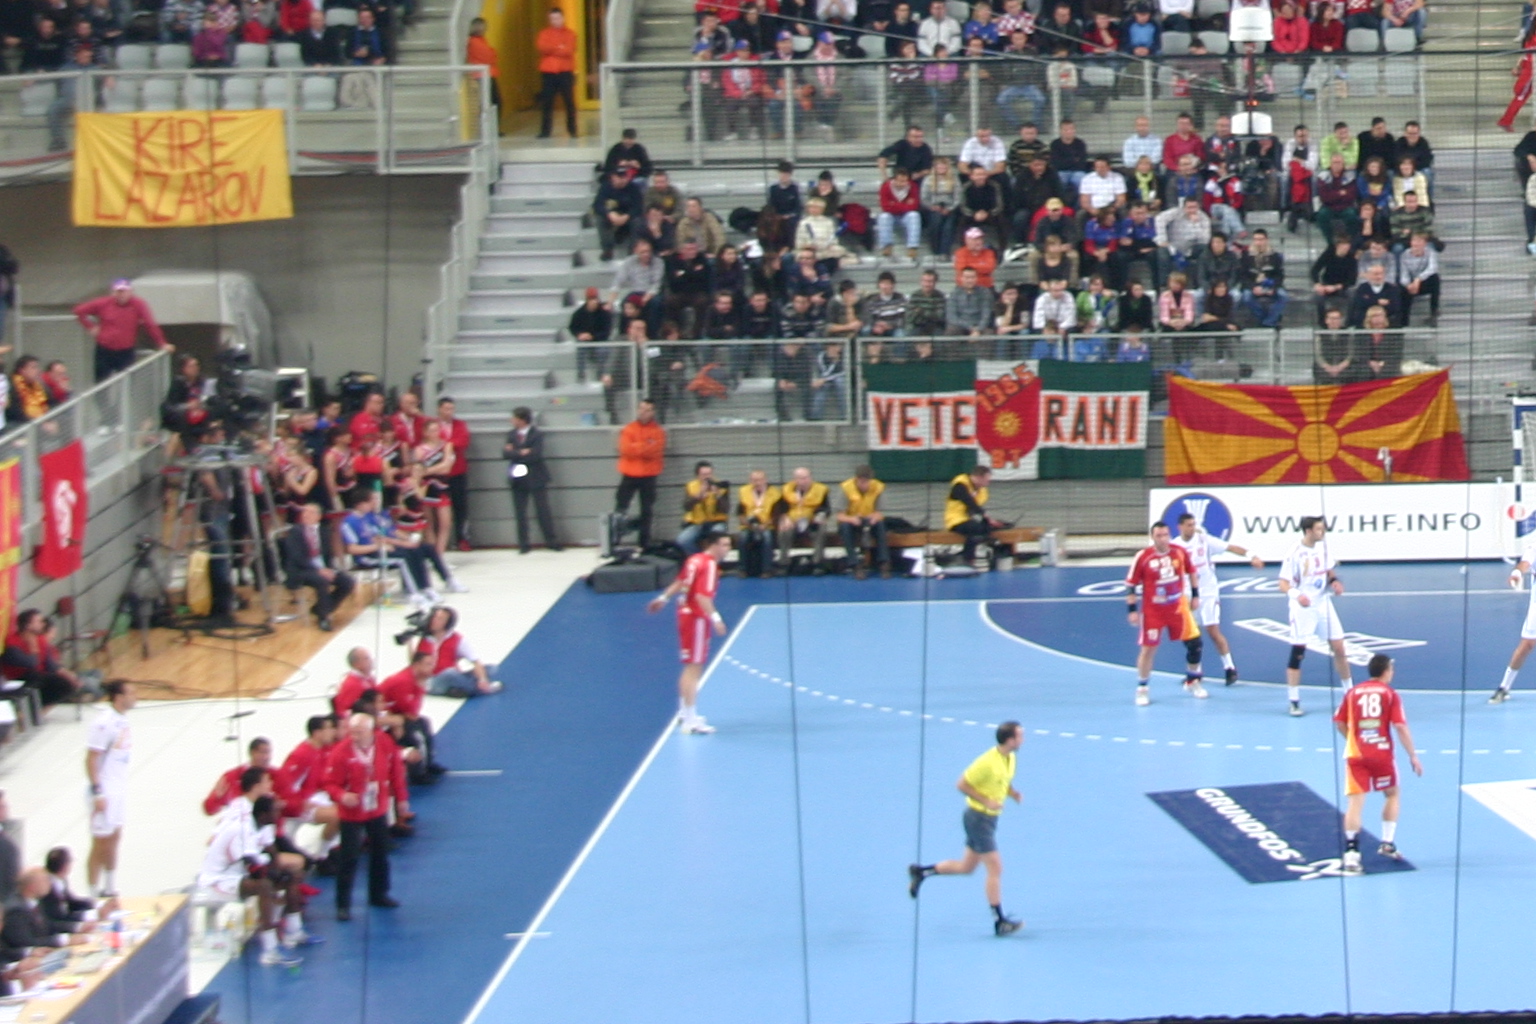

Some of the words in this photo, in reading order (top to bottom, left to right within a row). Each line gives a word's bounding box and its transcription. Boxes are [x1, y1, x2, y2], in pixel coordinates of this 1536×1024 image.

[132, 116, 238, 169] KIRE
[92, 165, 266, 224] LAZAROV
[1357, 692, 1382, 718] 18
[1195, 787, 1302, 862] GRUNDFOS
